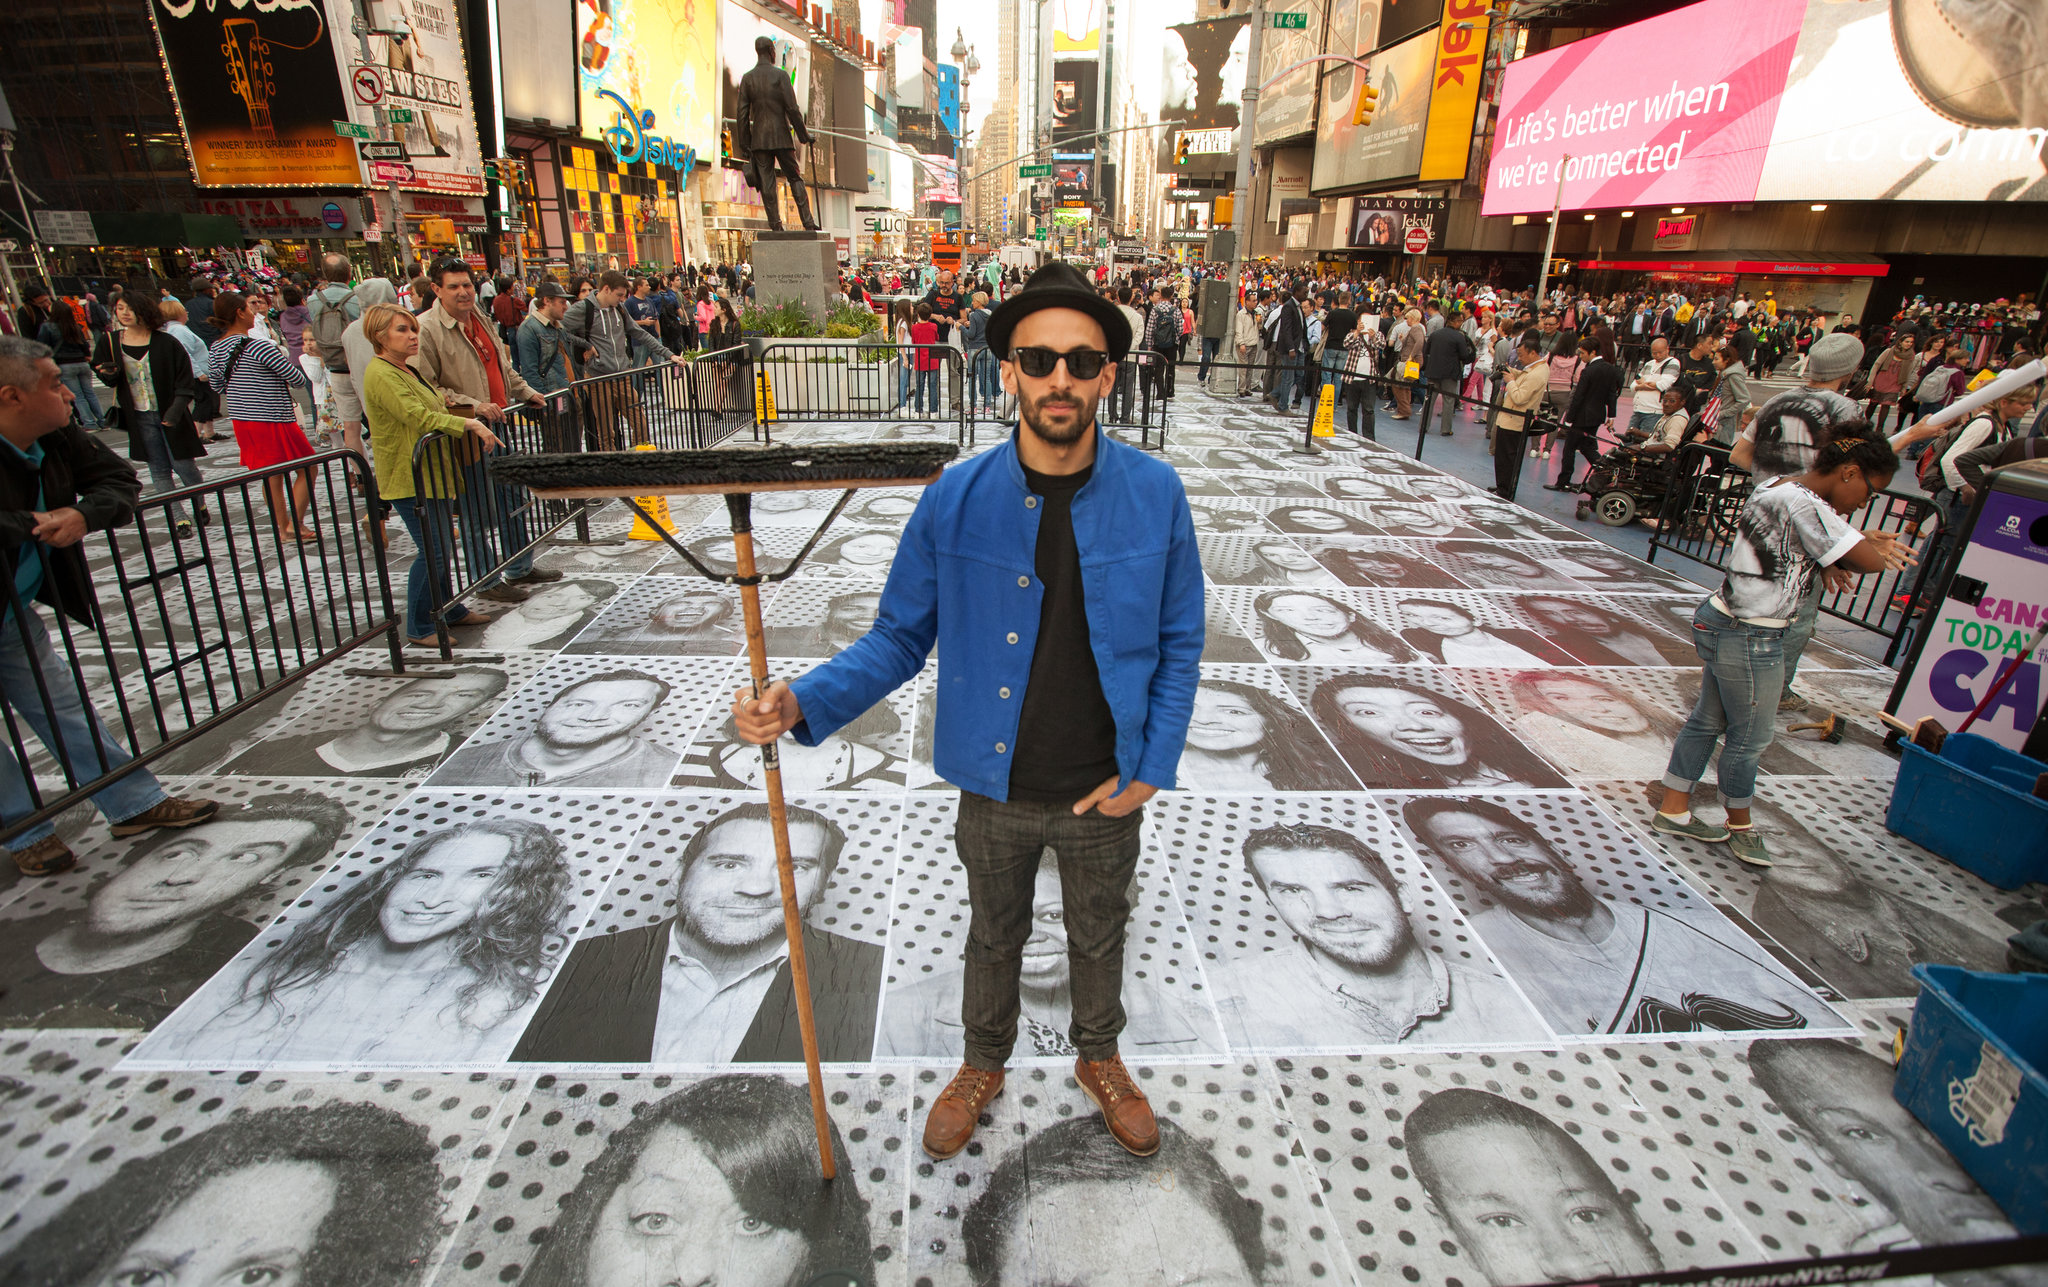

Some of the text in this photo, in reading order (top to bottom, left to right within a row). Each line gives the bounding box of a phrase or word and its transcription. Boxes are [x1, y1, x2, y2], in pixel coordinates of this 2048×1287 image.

[1276, 14, 1305, 28] W 46 ST
[380, 66, 462, 107] EWSIES
[390, 111, 397, 122] W
[397, 110, 405, 122] 46
[1504, 79, 1730, 149] Life's better when
[335, 123, 360, 137] TIMES
[1175, 130, 1232, 143] YWEATHER
[206, 138, 337, 150] WINNER! 2013 GRAMMY AWARD
[214, 149, 335, 160] BEST MUSICAL THEATER ALBUM
[370, 146, 399, 156] ONE WAY
[1498, 130, 1687, 189] we're connected
[381, 166, 395, 176] ONE
[396, 168, 410, 177] WAY
[1023, 167, 1048, 176] Broadway
[413, 197, 469, 213] DIGITAL
[1359, 199, 1446, 209] MARQUIS
[1401, 212, 1434, 230] Jekyll
[467, 225, 488, 233] SONY
[1654, 218, 1693, 240] Marriott
[365, 230, 382, 241] ATM
[1998, 525, 2020, 535] ALCOA
[1638, 1261, 1890, 1287] esSquareNYC.org
